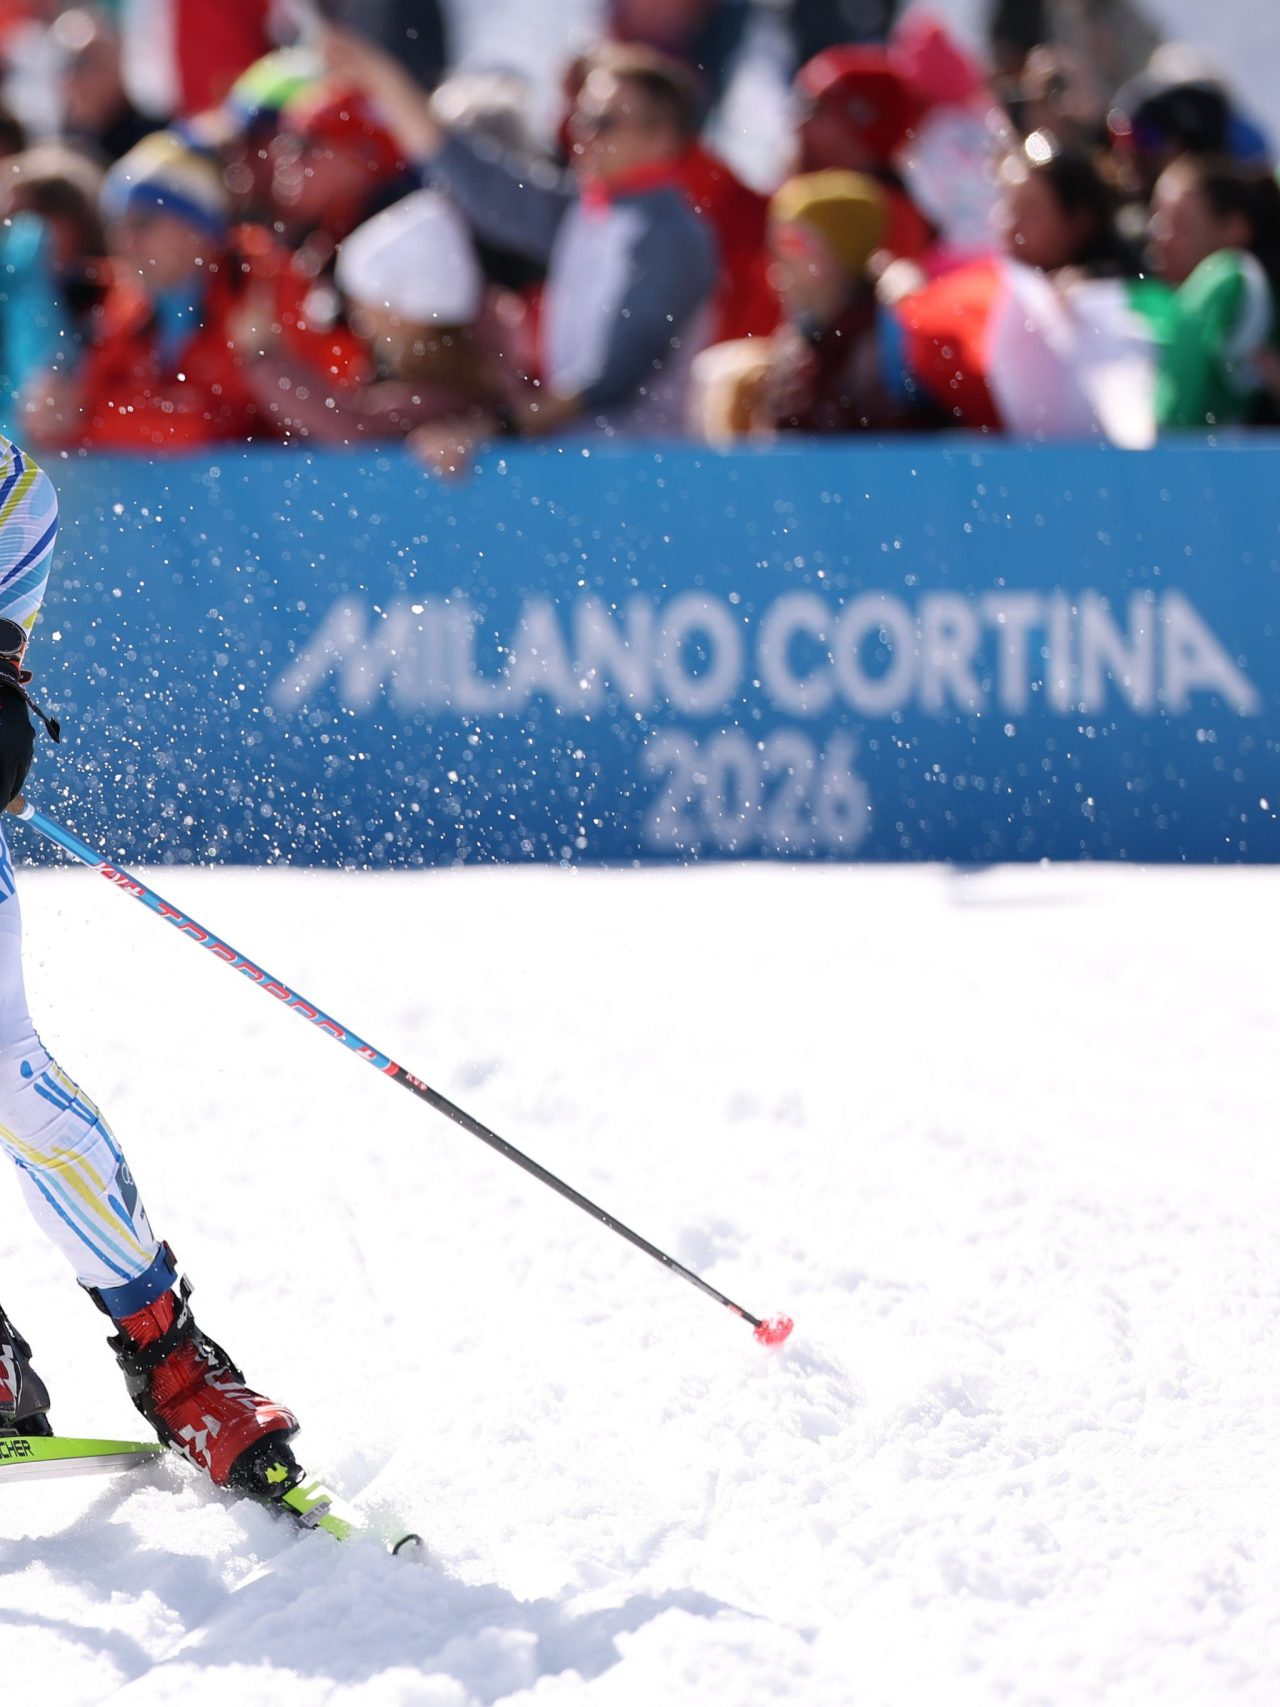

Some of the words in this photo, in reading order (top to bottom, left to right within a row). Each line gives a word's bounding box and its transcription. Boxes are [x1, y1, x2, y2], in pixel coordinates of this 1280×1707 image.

[270, 590, 746, 718] MILANO
[755, 590, 1261, 718] CORTINA
[641, 728, 871, 856] 2026
